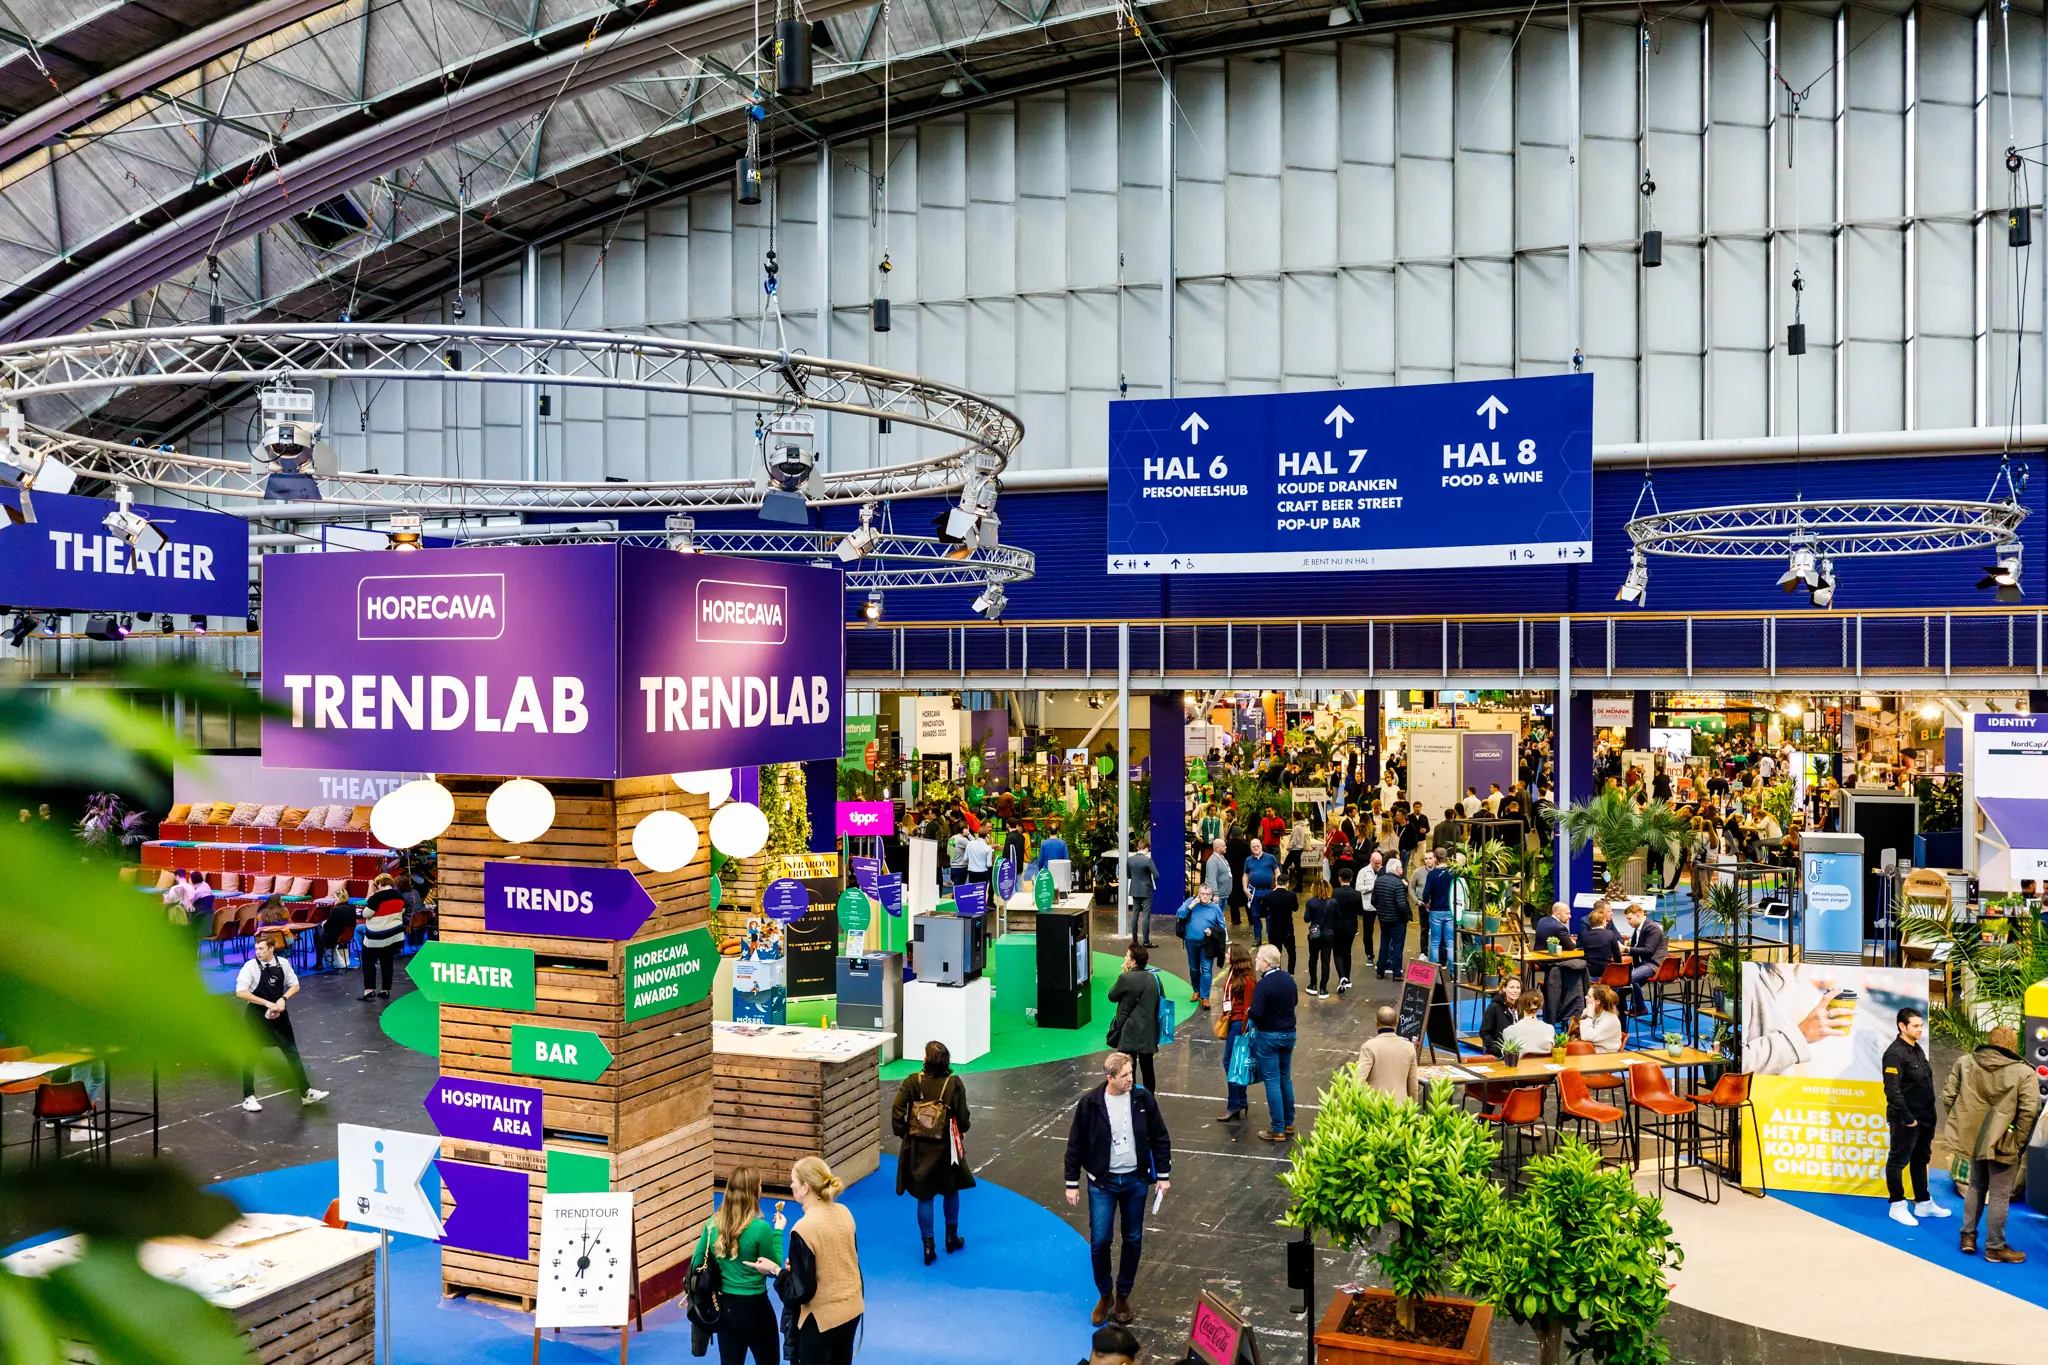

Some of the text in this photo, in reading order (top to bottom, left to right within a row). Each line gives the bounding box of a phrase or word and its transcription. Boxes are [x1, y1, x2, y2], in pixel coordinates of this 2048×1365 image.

[1278, 449, 1368, 476] HAL 7
[1443, 439, 1538, 469] HAL 8
[1143, 455, 1228, 481] HAL 6
[1441, 470, 1544, 488] FOOD & WINE
[1143, 484, 1248, 499] PERSONEELSHUB
[1277, 478, 1398, 495] KOUDE DRANKEN
[1277, 495, 1403, 513] CRAFT BEER STREET
[1277, 516, 1361, 532] POP-UP BAR
[49, 530, 216, 581] THEATER
[366, 593, 496, 621] HORECAVA
[702, 599, 783, 627] HORECAVA
[284, 674, 589, 735] TRENDLAB
[639, 675, 830, 734] TRENDLAB
[1988, 717, 2037, 727] IDENTITY
[2011, 741, 2042, 749] NordCap
[503, 886, 594, 915] TRENDS
[634, 943, 689, 970] HORECAVA
[430, 962, 514, 989] THEATER
[634, 958, 701, 990] INNOVATION
[634, 986, 679, 1010] AWARDS
[535, 1040, 578, 1066] BAR
[441, 1089, 533, 1116] HOSPITALITY
[492, 1117, 533, 1137] AREA
[1770, 1108, 1832, 1126] ALLES
[1763, 1123, 1891, 1147] HET PERFECT
[1764, 1140, 1827, 1160] KOPJE
[554, 1208, 619, 1219] TRENDTOUR
